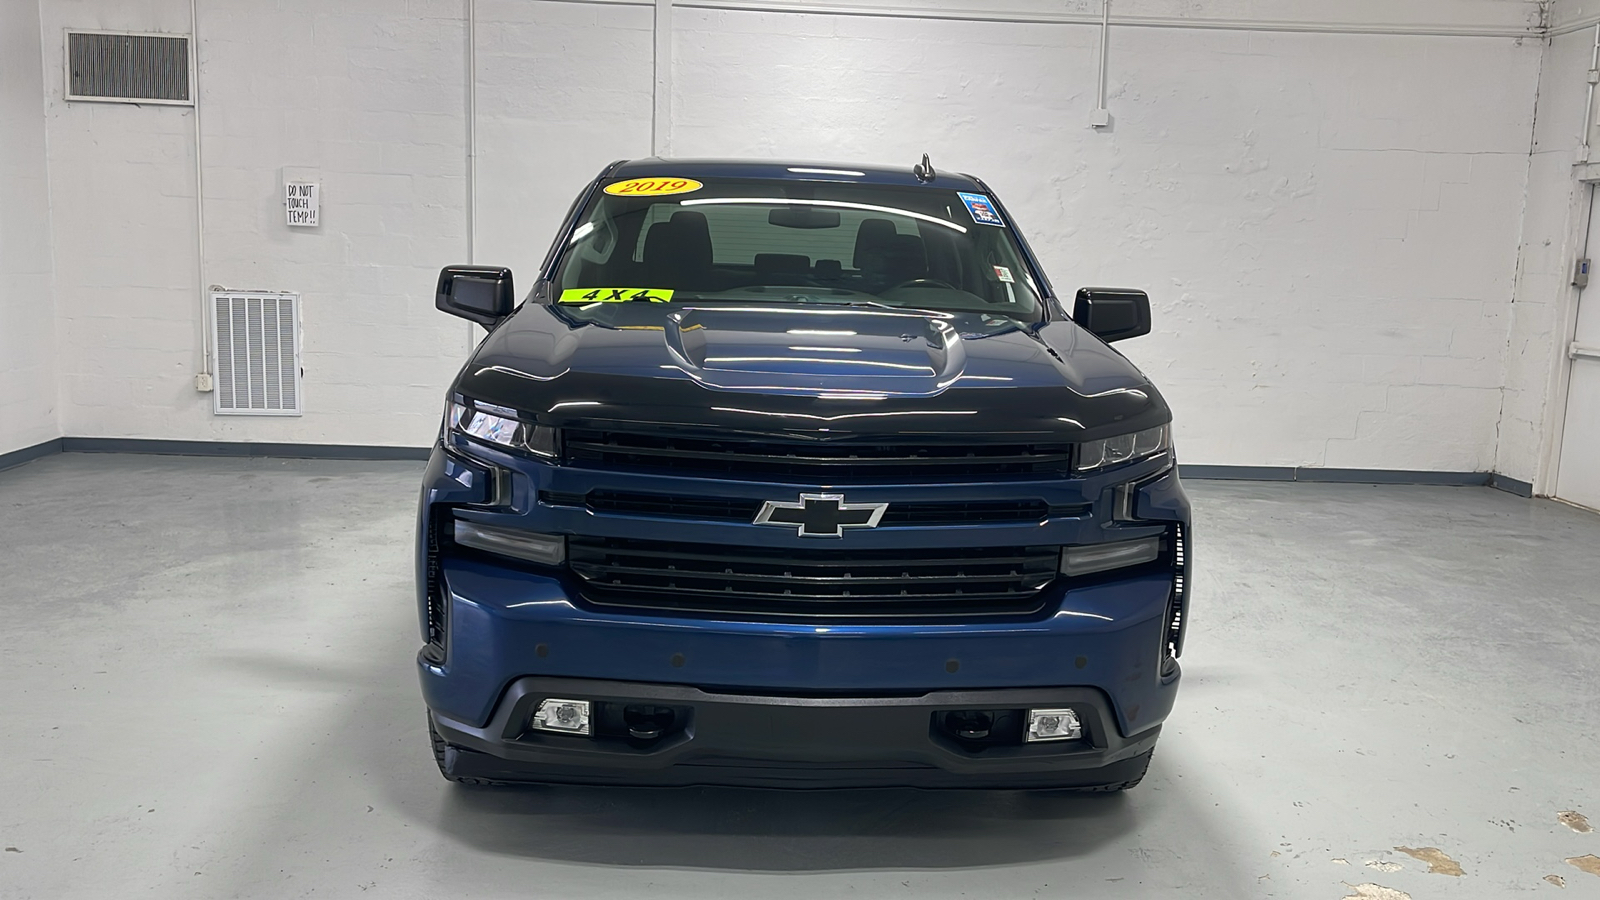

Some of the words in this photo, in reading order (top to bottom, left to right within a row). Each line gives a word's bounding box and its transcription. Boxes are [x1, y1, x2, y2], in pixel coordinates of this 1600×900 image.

[288, 184, 297, 197] DO
[299, 185, 314, 198] NOT
[618, 180, 688, 193] 2019
[287, 197, 309, 209] TOUCH
[288, 210, 316, 224] TEMP!!
